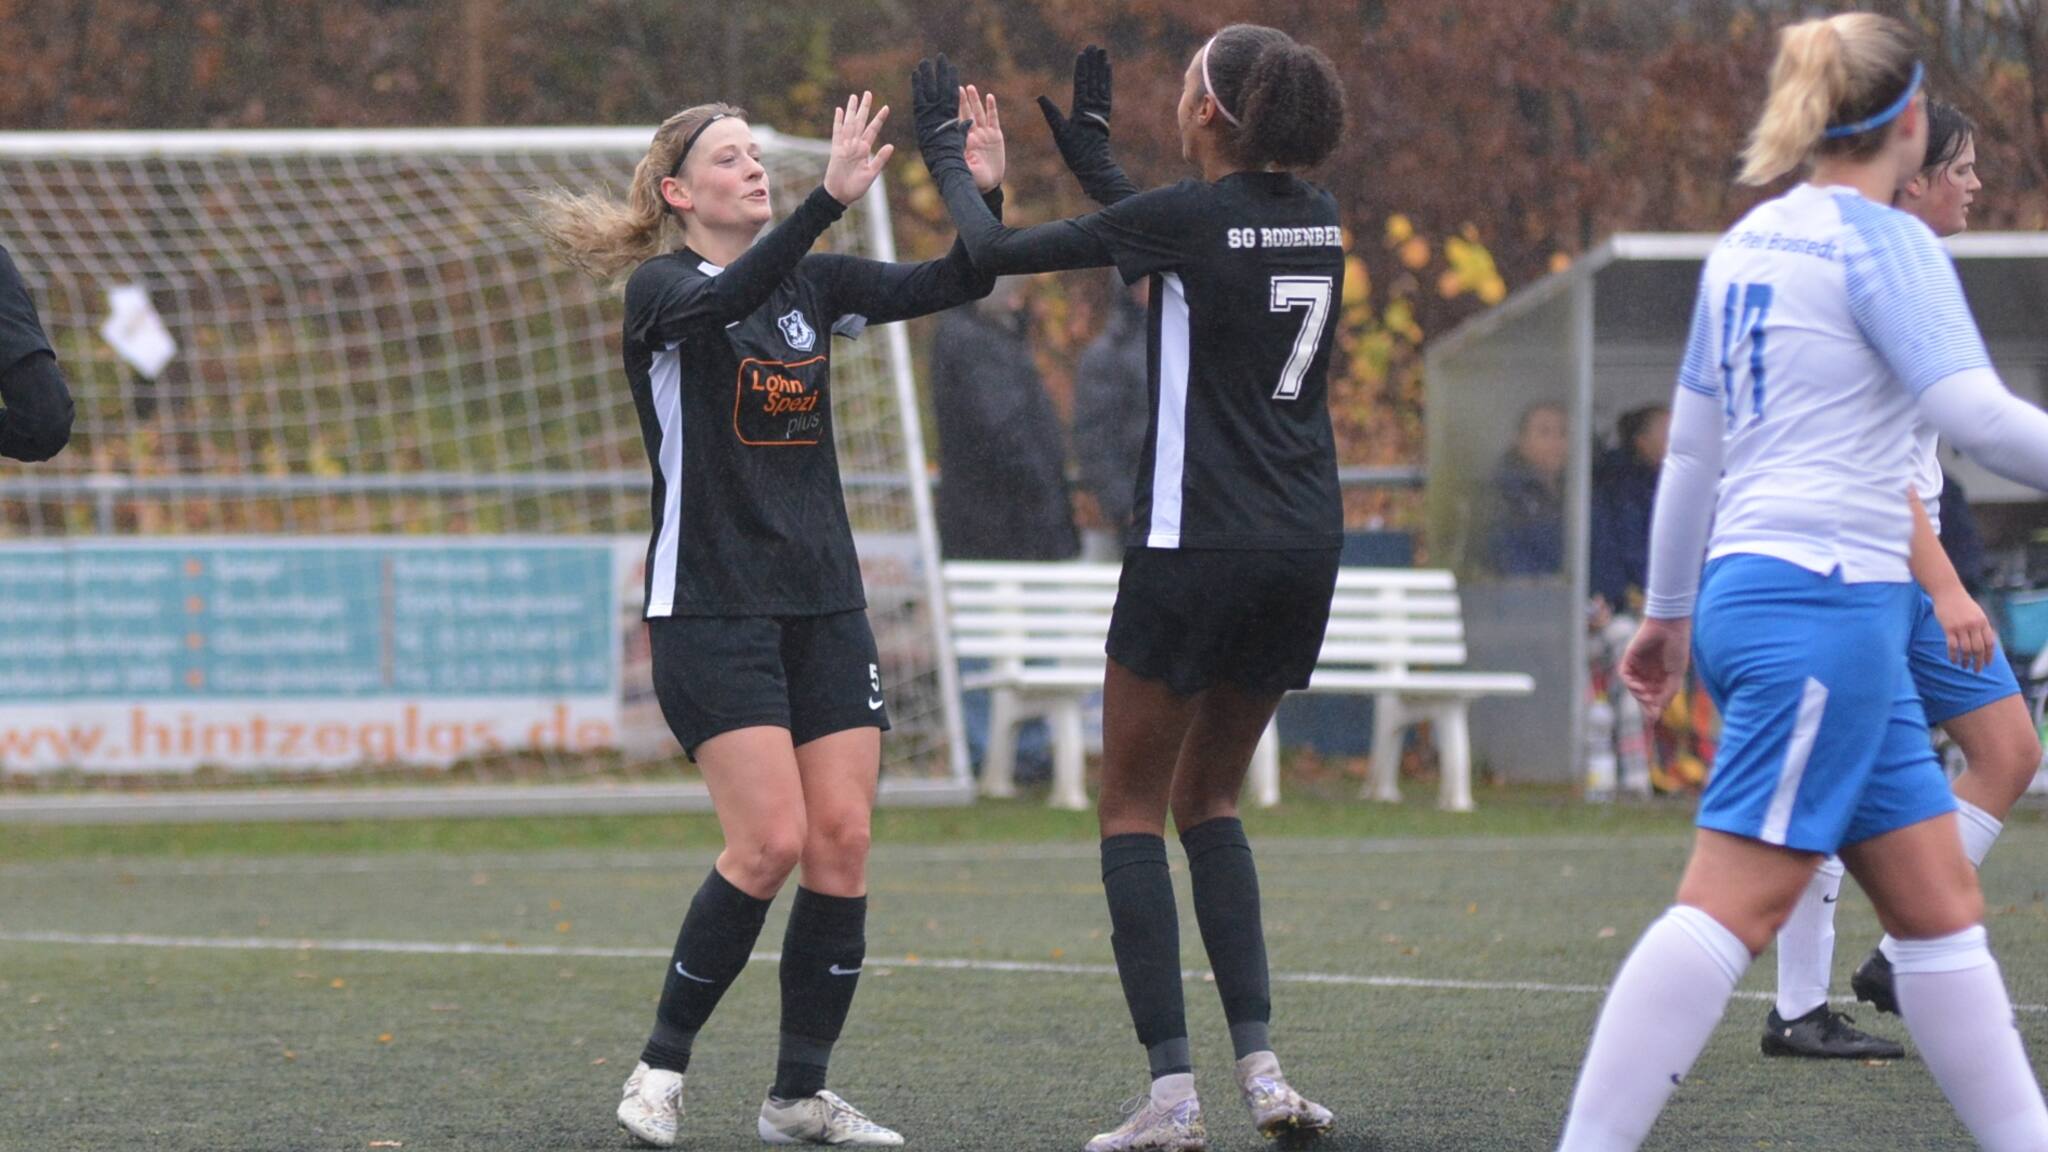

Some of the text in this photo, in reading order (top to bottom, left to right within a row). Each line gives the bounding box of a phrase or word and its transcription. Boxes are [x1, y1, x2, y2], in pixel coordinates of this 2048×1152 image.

[1227, 227, 1256, 249] SG
[1269, 275, 1333, 400] 7
[1720, 282, 1774, 429] 17
[751, 370, 803, 393] Lohn
[763, 390, 819, 417] Spezi
[786, 413, 820, 439] plus
[869, 663, 880, 692] 5
